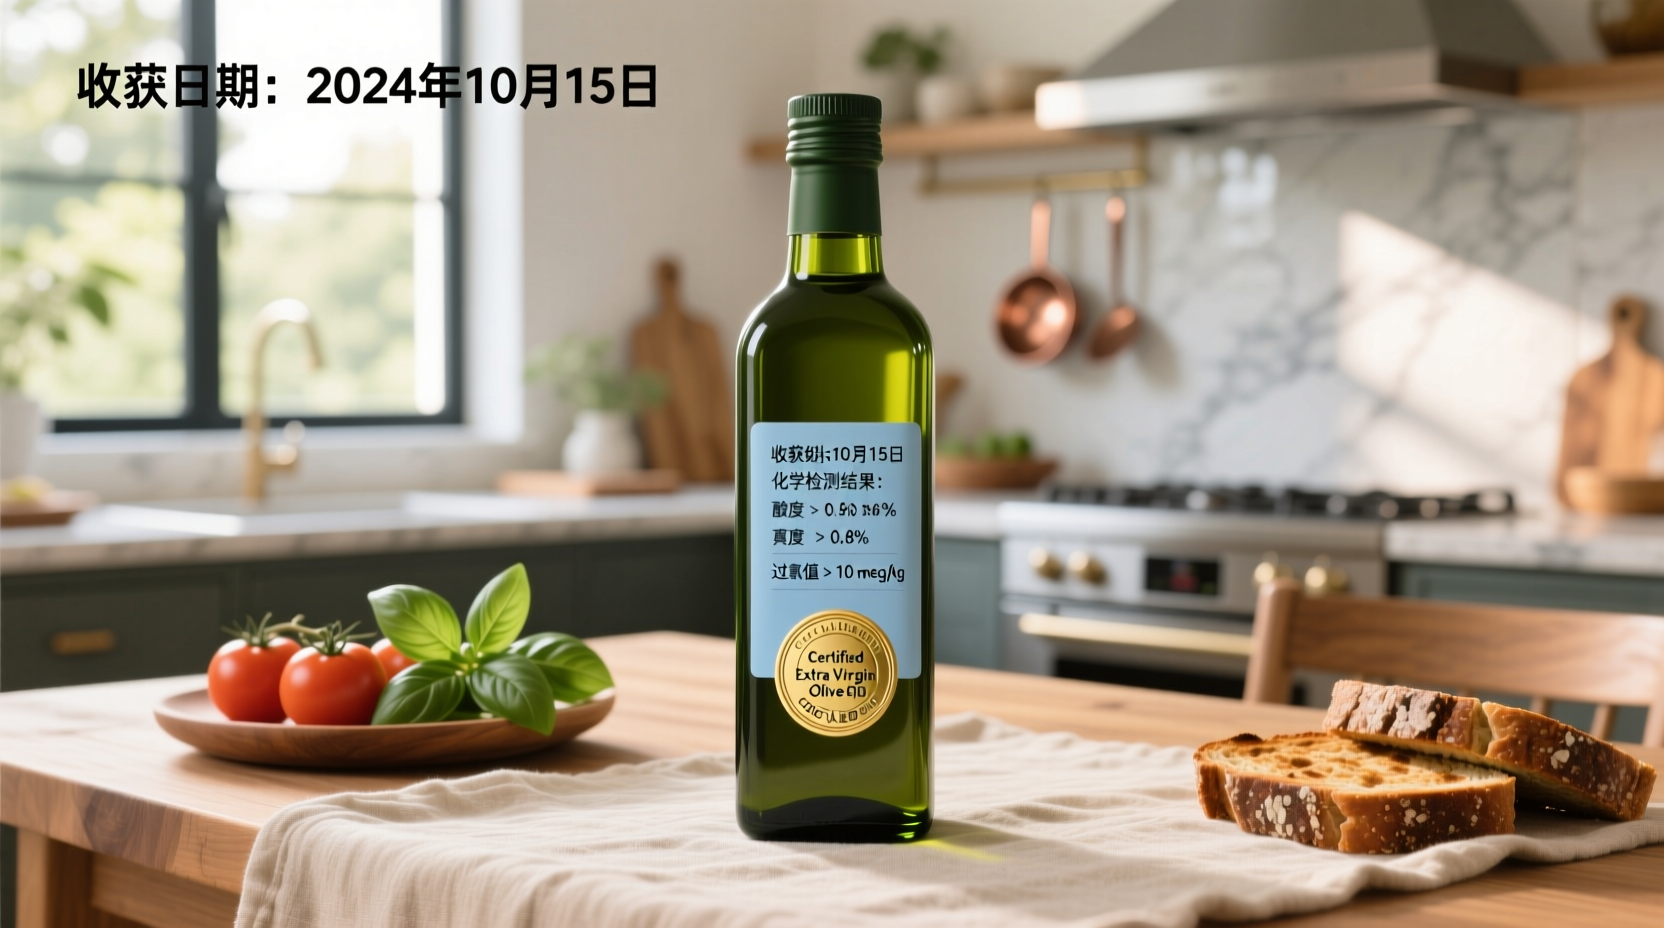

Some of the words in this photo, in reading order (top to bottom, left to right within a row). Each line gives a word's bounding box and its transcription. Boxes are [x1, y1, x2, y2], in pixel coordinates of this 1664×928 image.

[810, 505, 819, 514] >
[816, 532, 825, 543] >
[823, 567, 832, 577] >
[836, 565, 854, 578] 10
[808, 650, 864, 663] Certified
[796, 668, 830, 681] Extra
[833, 668, 876, 685] Virgin
[809, 684, 844, 697] Olive
